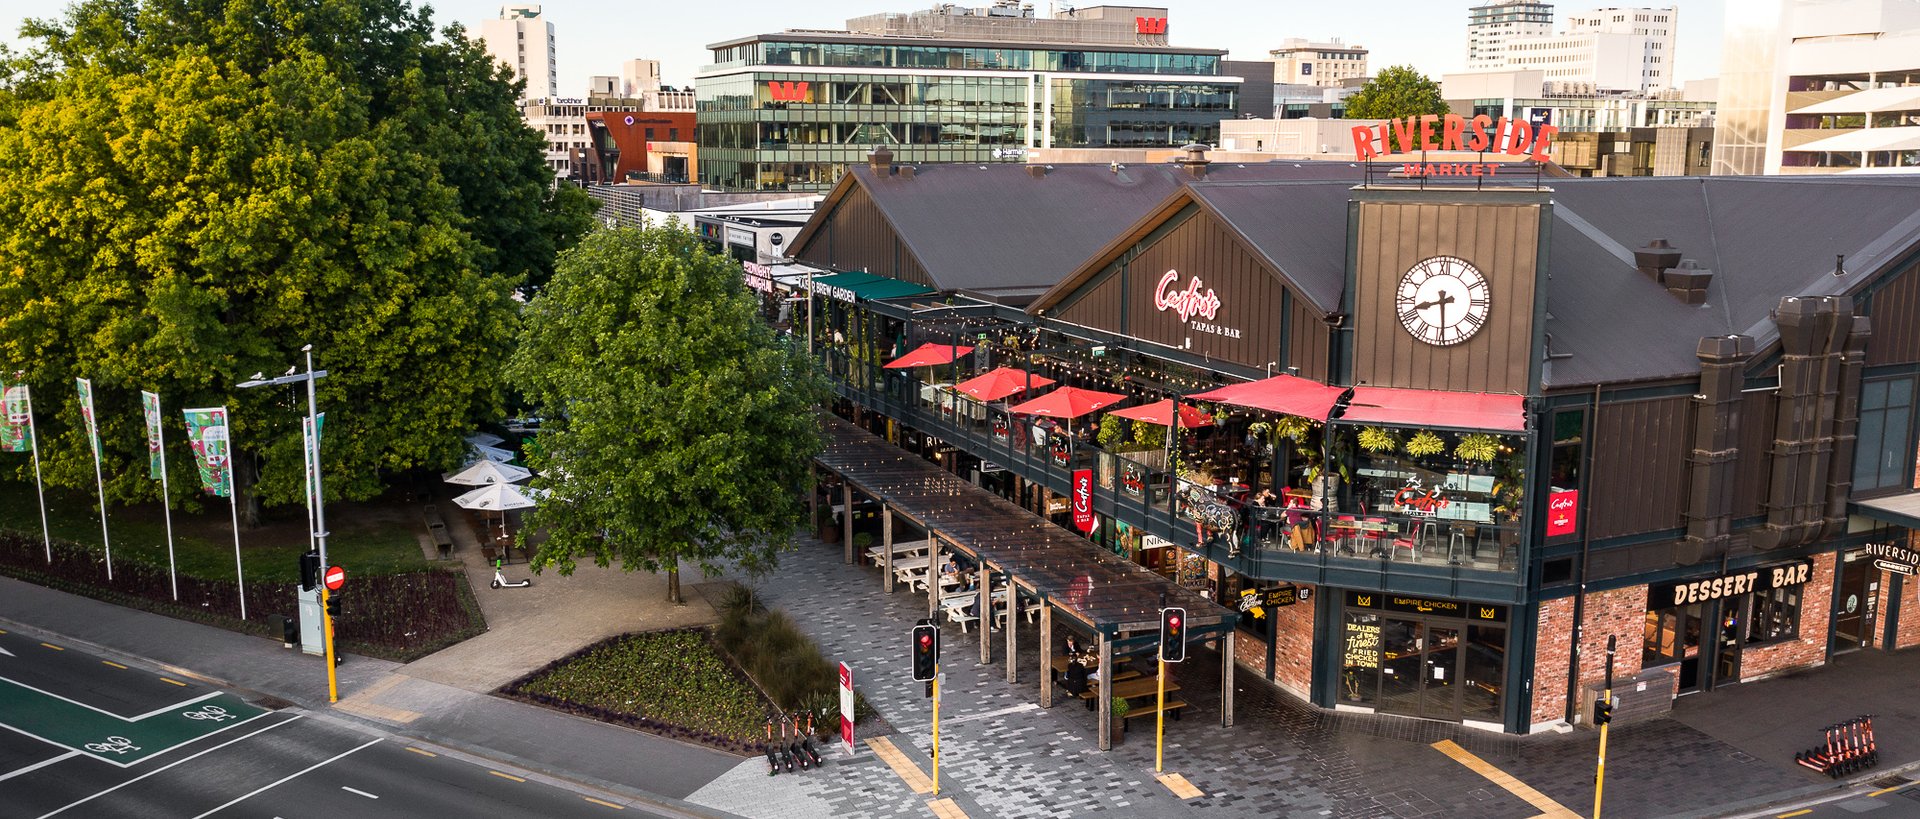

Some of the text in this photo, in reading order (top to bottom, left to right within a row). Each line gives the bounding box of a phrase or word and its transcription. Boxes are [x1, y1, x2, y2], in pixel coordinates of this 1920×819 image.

[1351, 113, 1559, 164] RIVERSIDE
[1404, 163, 1500, 178] MARKET
[798, 277, 856, 304] KAISR BREW GARDEN
[1155, 269, 1221, 323] Castro's
[1191, 321, 1241, 339] TAPAS & BAR
[1147, 537, 1168, 546] NIK
[1865, 543, 1920, 566] RIVERSID
[1674, 564, 1808, 605] DESSERT BAR
[1266, 597, 1294, 606] CHICKEN
[1268, 590, 1293, 599] EMPIRE
[1394, 597, 1422, 606] EMPIRE
[1424, 601, 1457, 610] CHICKEN
[1347, 623, 1380, 633] DEALERS
[1347, 636, 1379, 651] finest
[1345, 653, 1378, 662] CHICKEN
[1353, 648, 1378, 656] FRIED
[1357, 660, 1378, 669] TOWN
